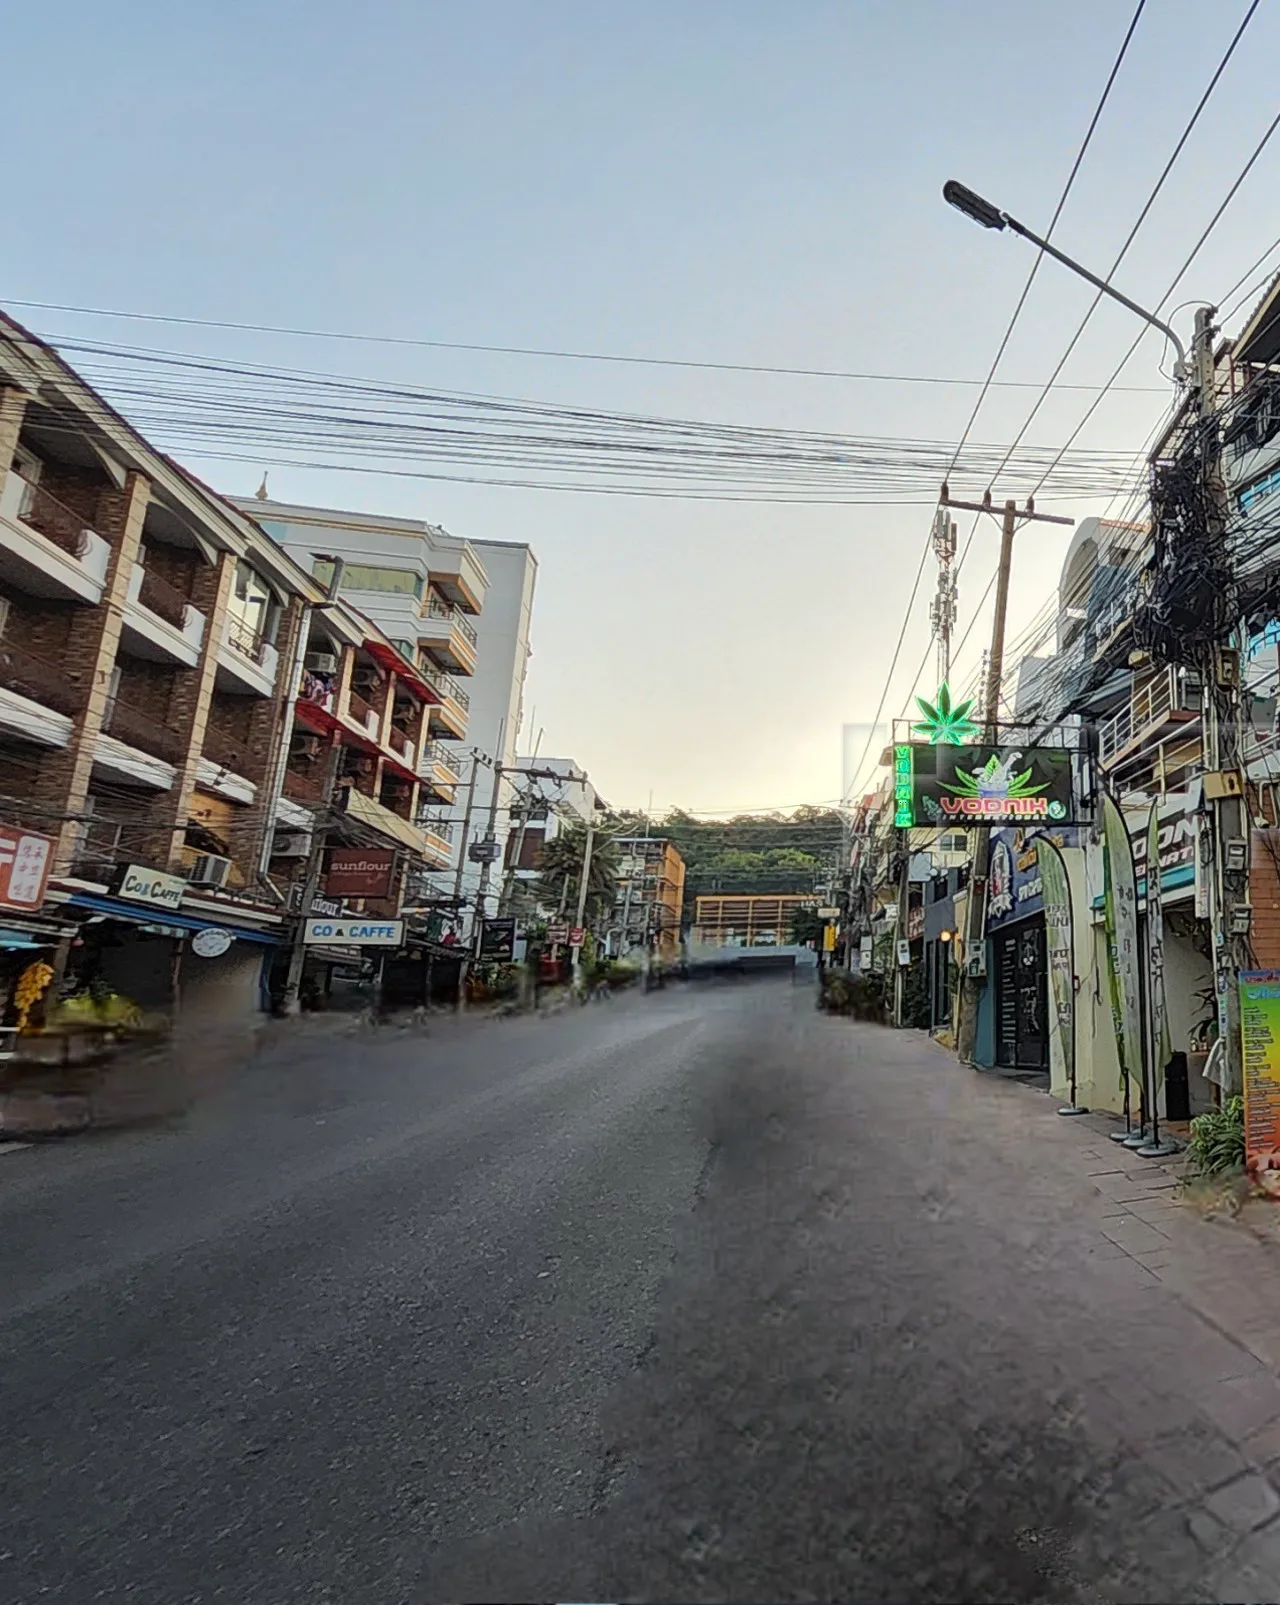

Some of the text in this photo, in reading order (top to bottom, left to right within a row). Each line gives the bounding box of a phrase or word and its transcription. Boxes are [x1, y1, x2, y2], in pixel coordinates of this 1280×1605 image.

[940, 796, 1048, 815] VODNIK
[330, 860, 392, 871] sunflour
[312, 925, 333, 937] CO
[349, 926, 396, 938] CAFFE
